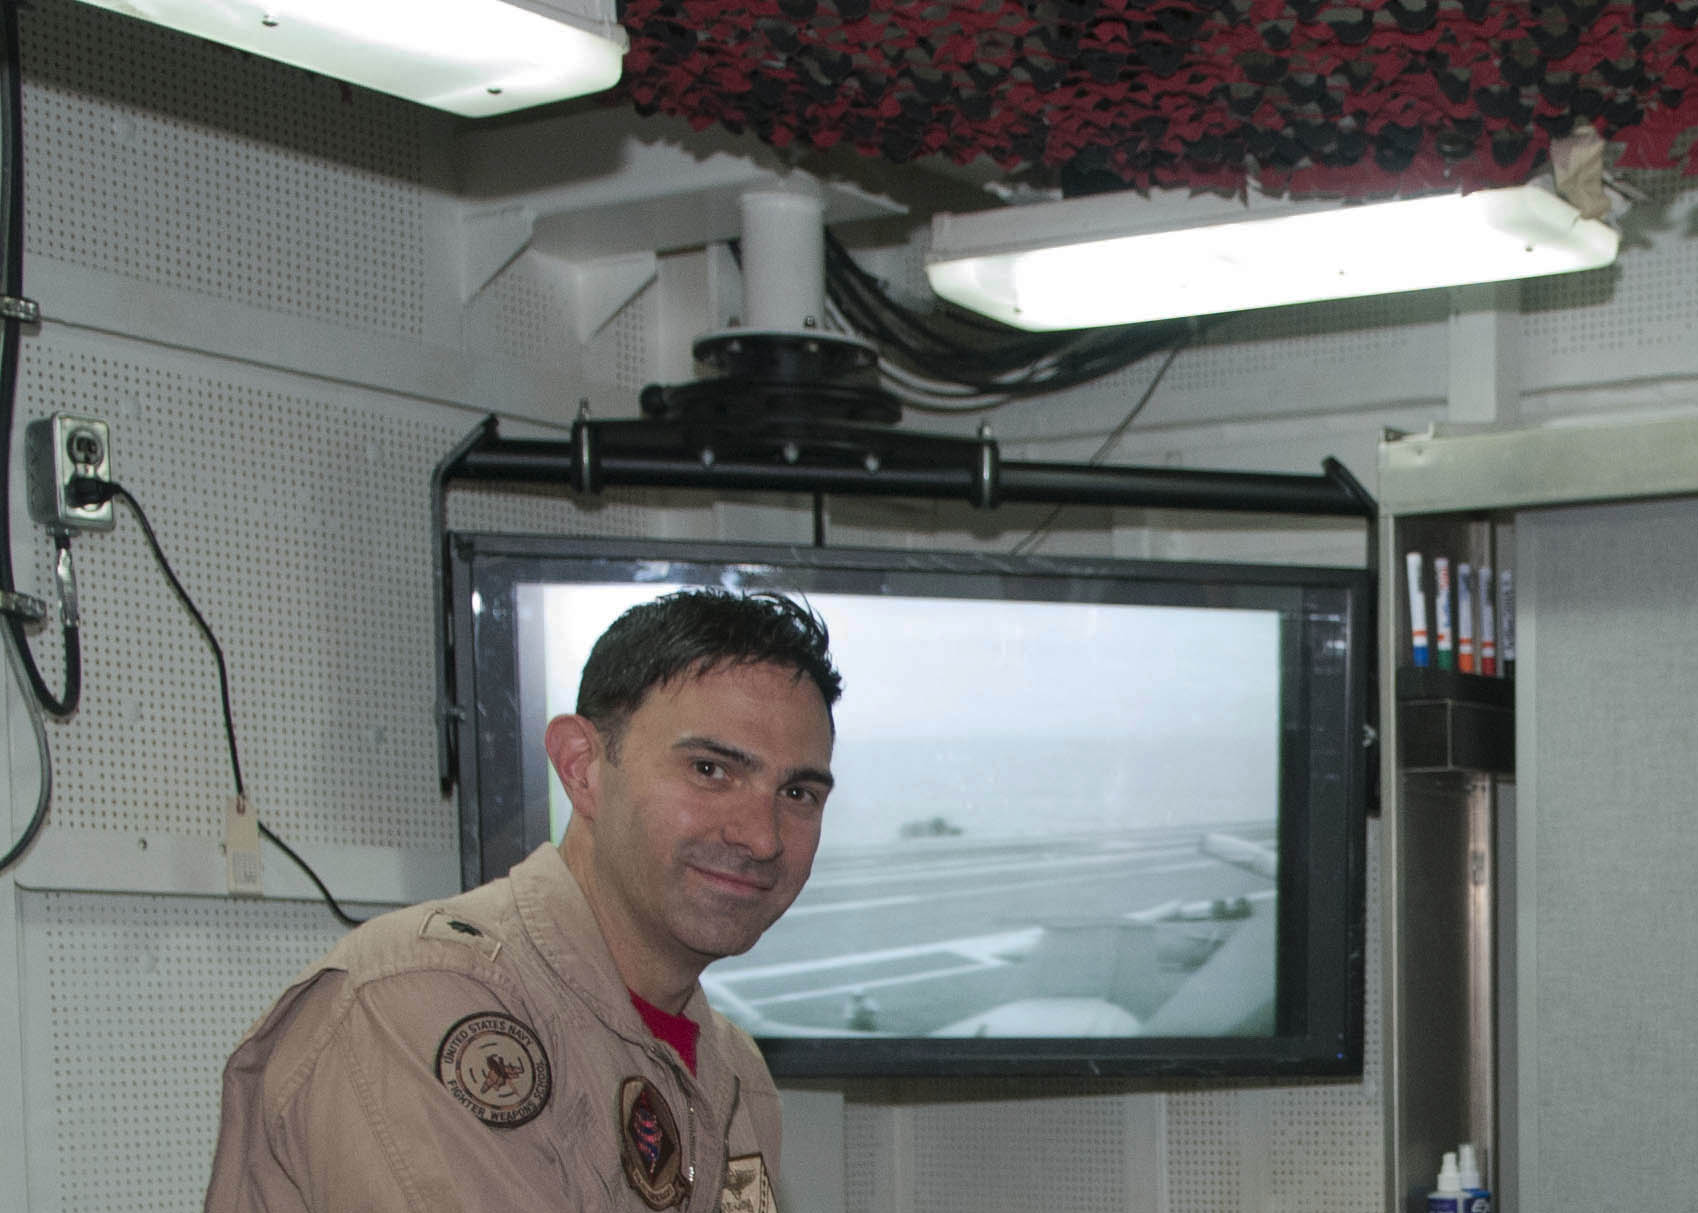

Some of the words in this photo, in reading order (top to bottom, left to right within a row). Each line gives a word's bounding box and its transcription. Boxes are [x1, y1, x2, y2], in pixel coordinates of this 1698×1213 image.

[444, 1030, 468, 1064] UNITED
[468, 1020, 506, 1034] STATES
[508, 1025, 533, 1046] NAVY
[448, 1080, 486, 1118] FIGHTER
[491, 1101, 537, 1121] WEAPONS
[534, 1061, 547, 1100] SCHOOL
